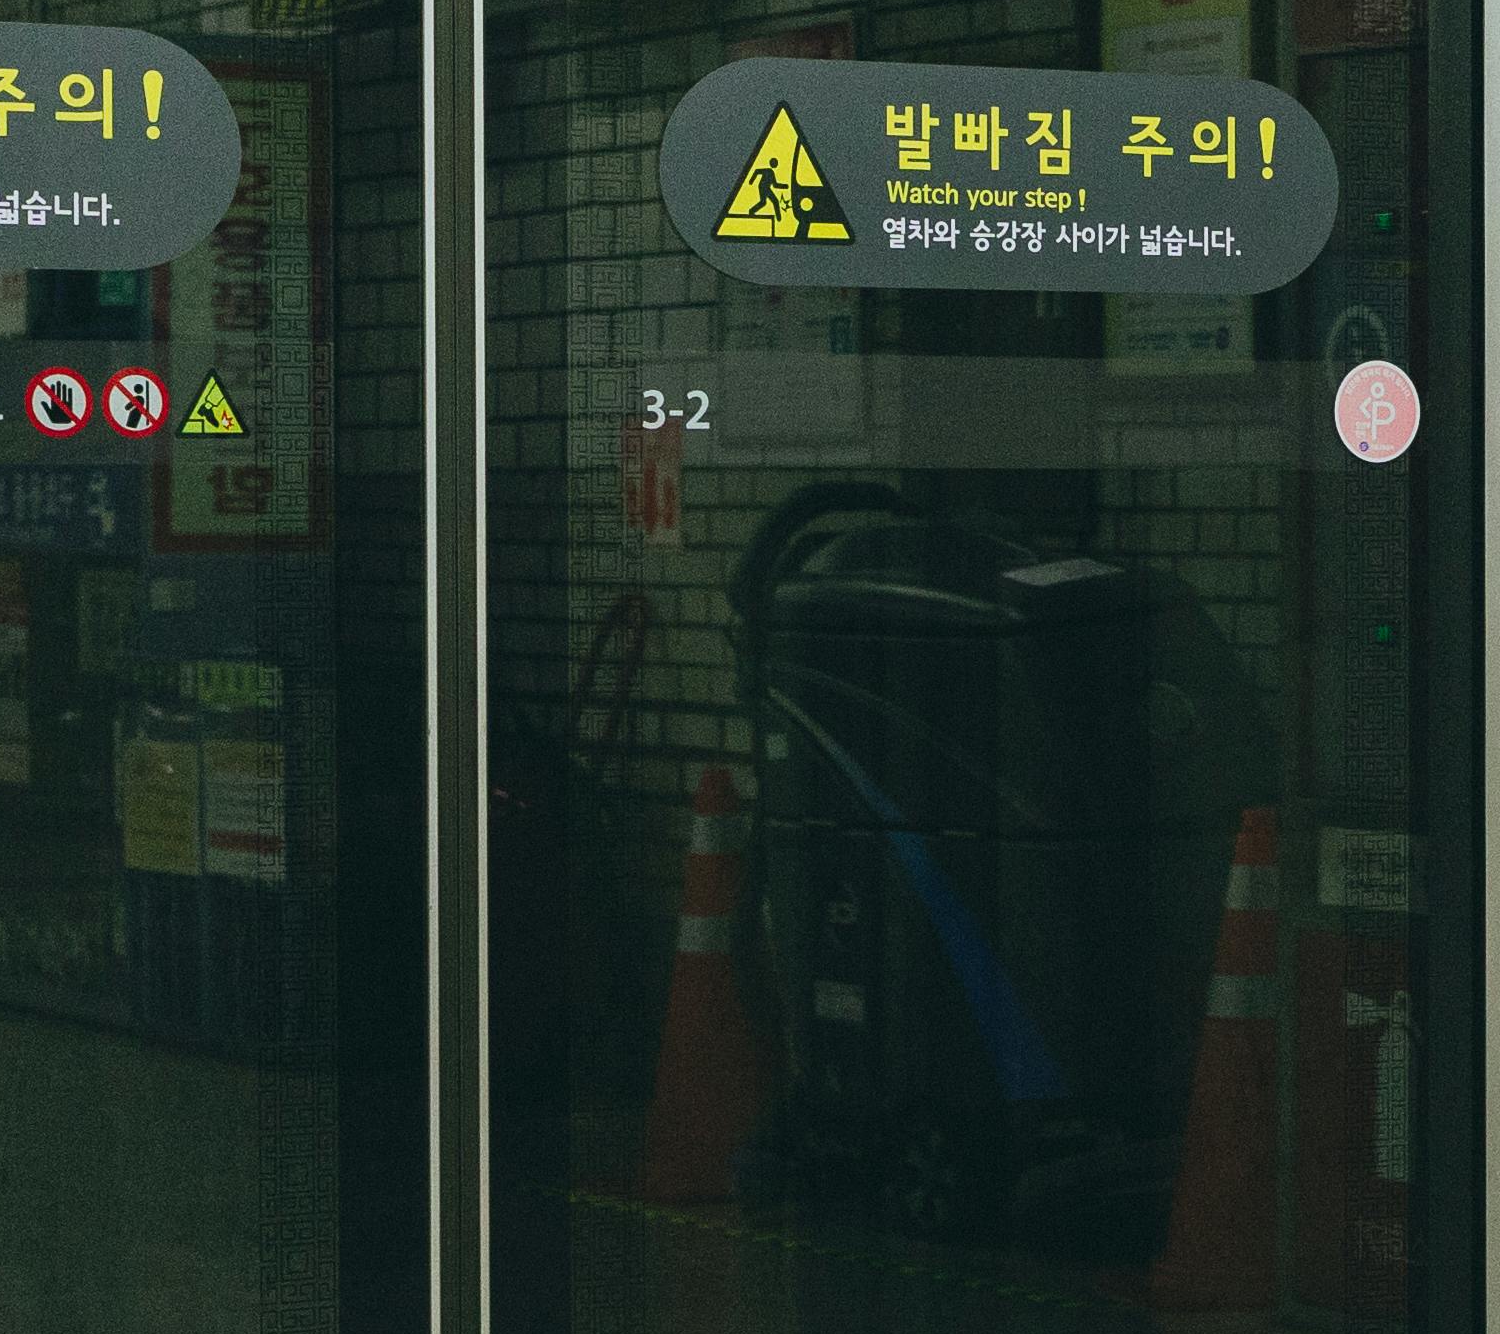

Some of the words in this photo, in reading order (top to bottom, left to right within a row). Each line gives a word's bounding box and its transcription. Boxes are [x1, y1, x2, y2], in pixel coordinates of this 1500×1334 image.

[887, 180, 960, 208] Watch
[967, 187, 1019, 211] your
[882, 218, 960, 250] 열차와
[969, 219, 1046, 254] 승강장
[1055, 221, 1130, 255] 사이가
[1138, 224, 1243, 258] 넓습니다.
[641, 388, 711, 430] 3-2
